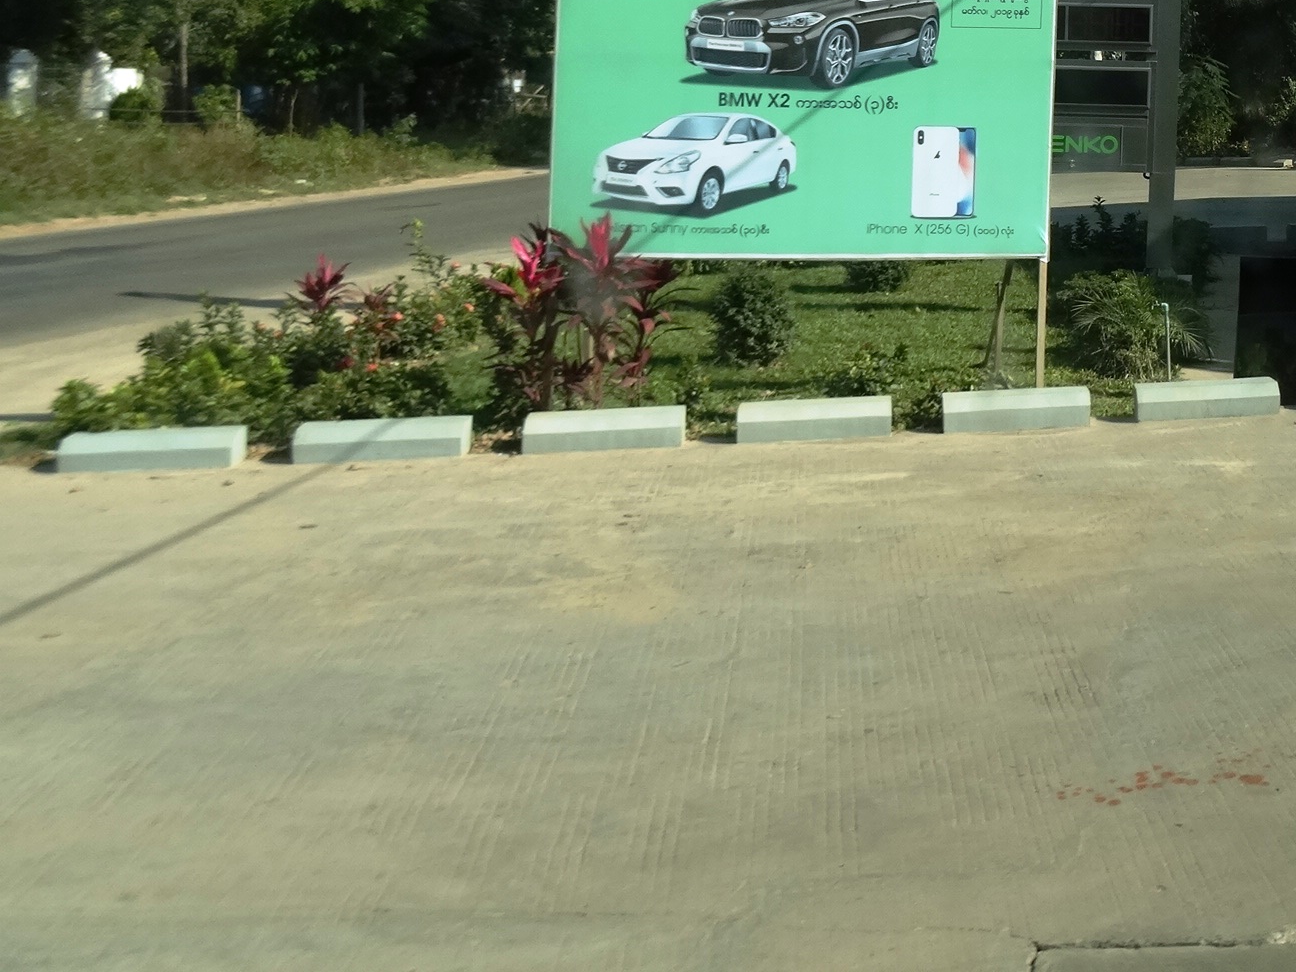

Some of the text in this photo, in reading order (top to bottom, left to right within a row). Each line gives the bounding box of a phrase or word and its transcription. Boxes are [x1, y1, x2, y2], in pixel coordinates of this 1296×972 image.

[718, 92, 762, 107] BMW
[767, 93, 790, 108] X2
[651, 222, 689, 236] Sunny
[866, 223, 908, 235] iPhone
[914, 223, 923, 235] X
[926, 223, 952, 237] (256
[955, 223, 970, 237] G)
